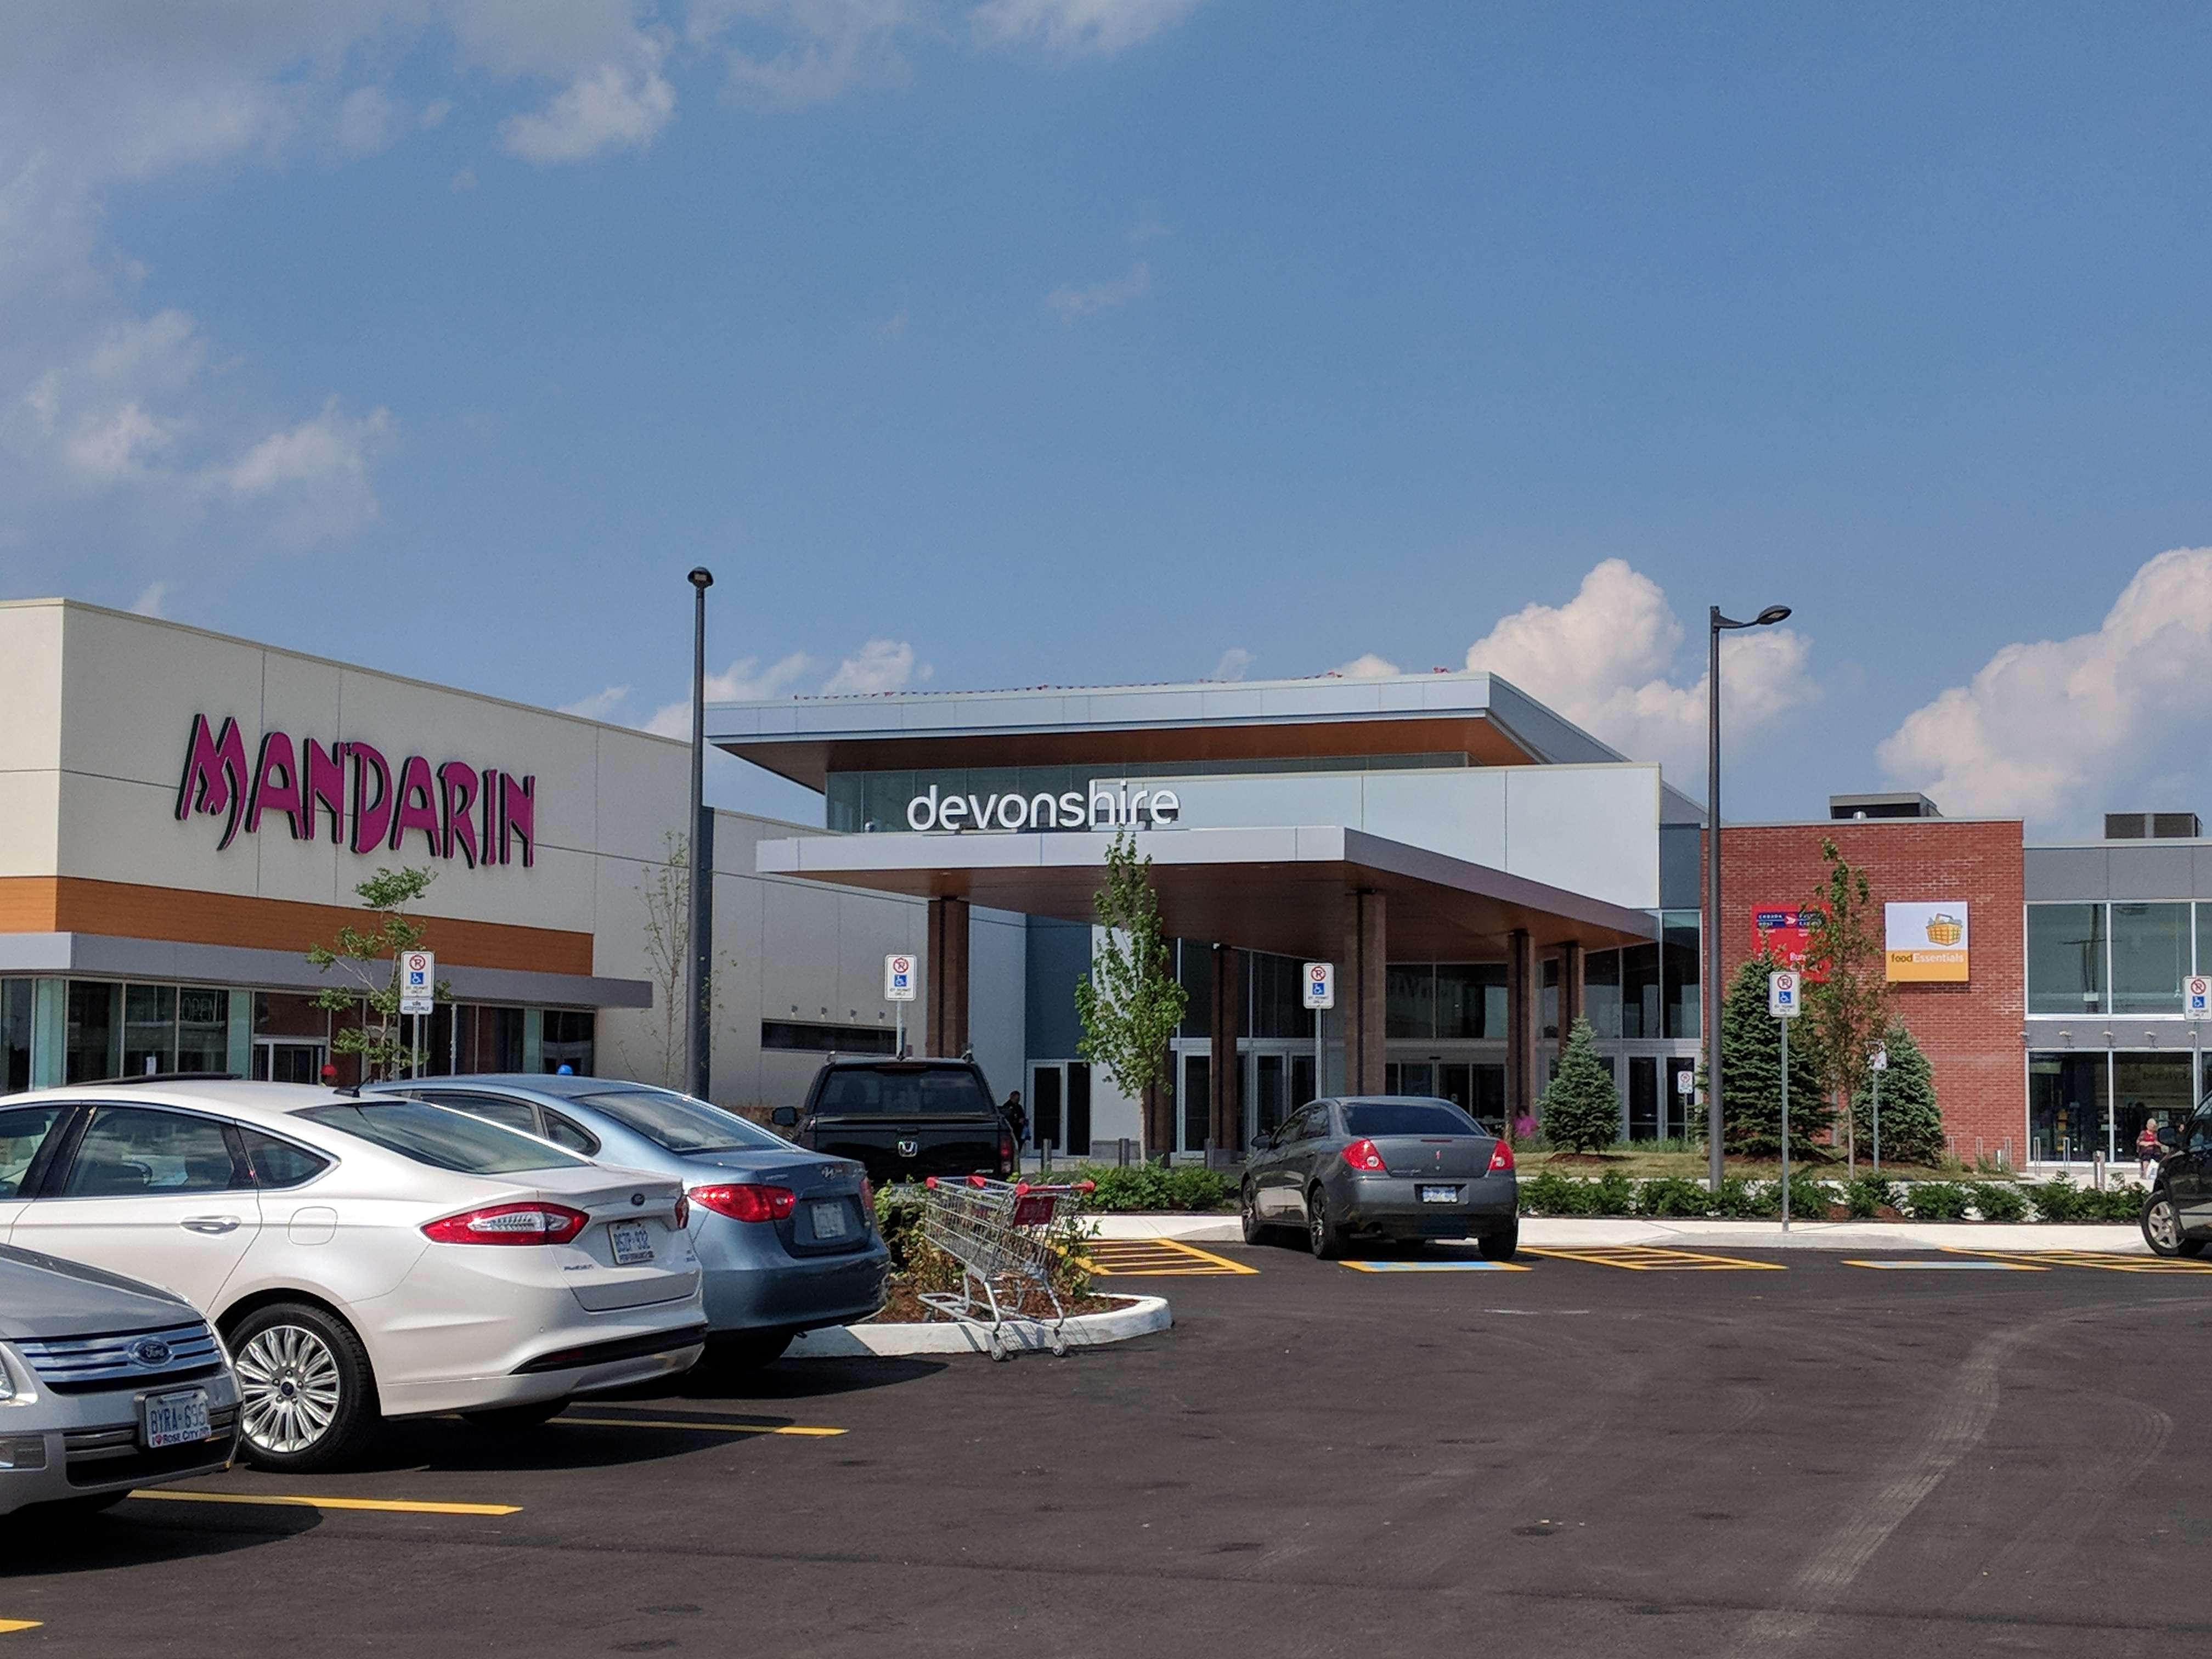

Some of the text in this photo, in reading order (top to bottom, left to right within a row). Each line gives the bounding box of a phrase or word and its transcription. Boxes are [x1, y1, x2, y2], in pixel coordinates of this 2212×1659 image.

[175, 714, 535, 869] MANDARIN
[907, 779, 1180, 831] devonshire
[1891, 952, 1964, 963] foodEssentials
